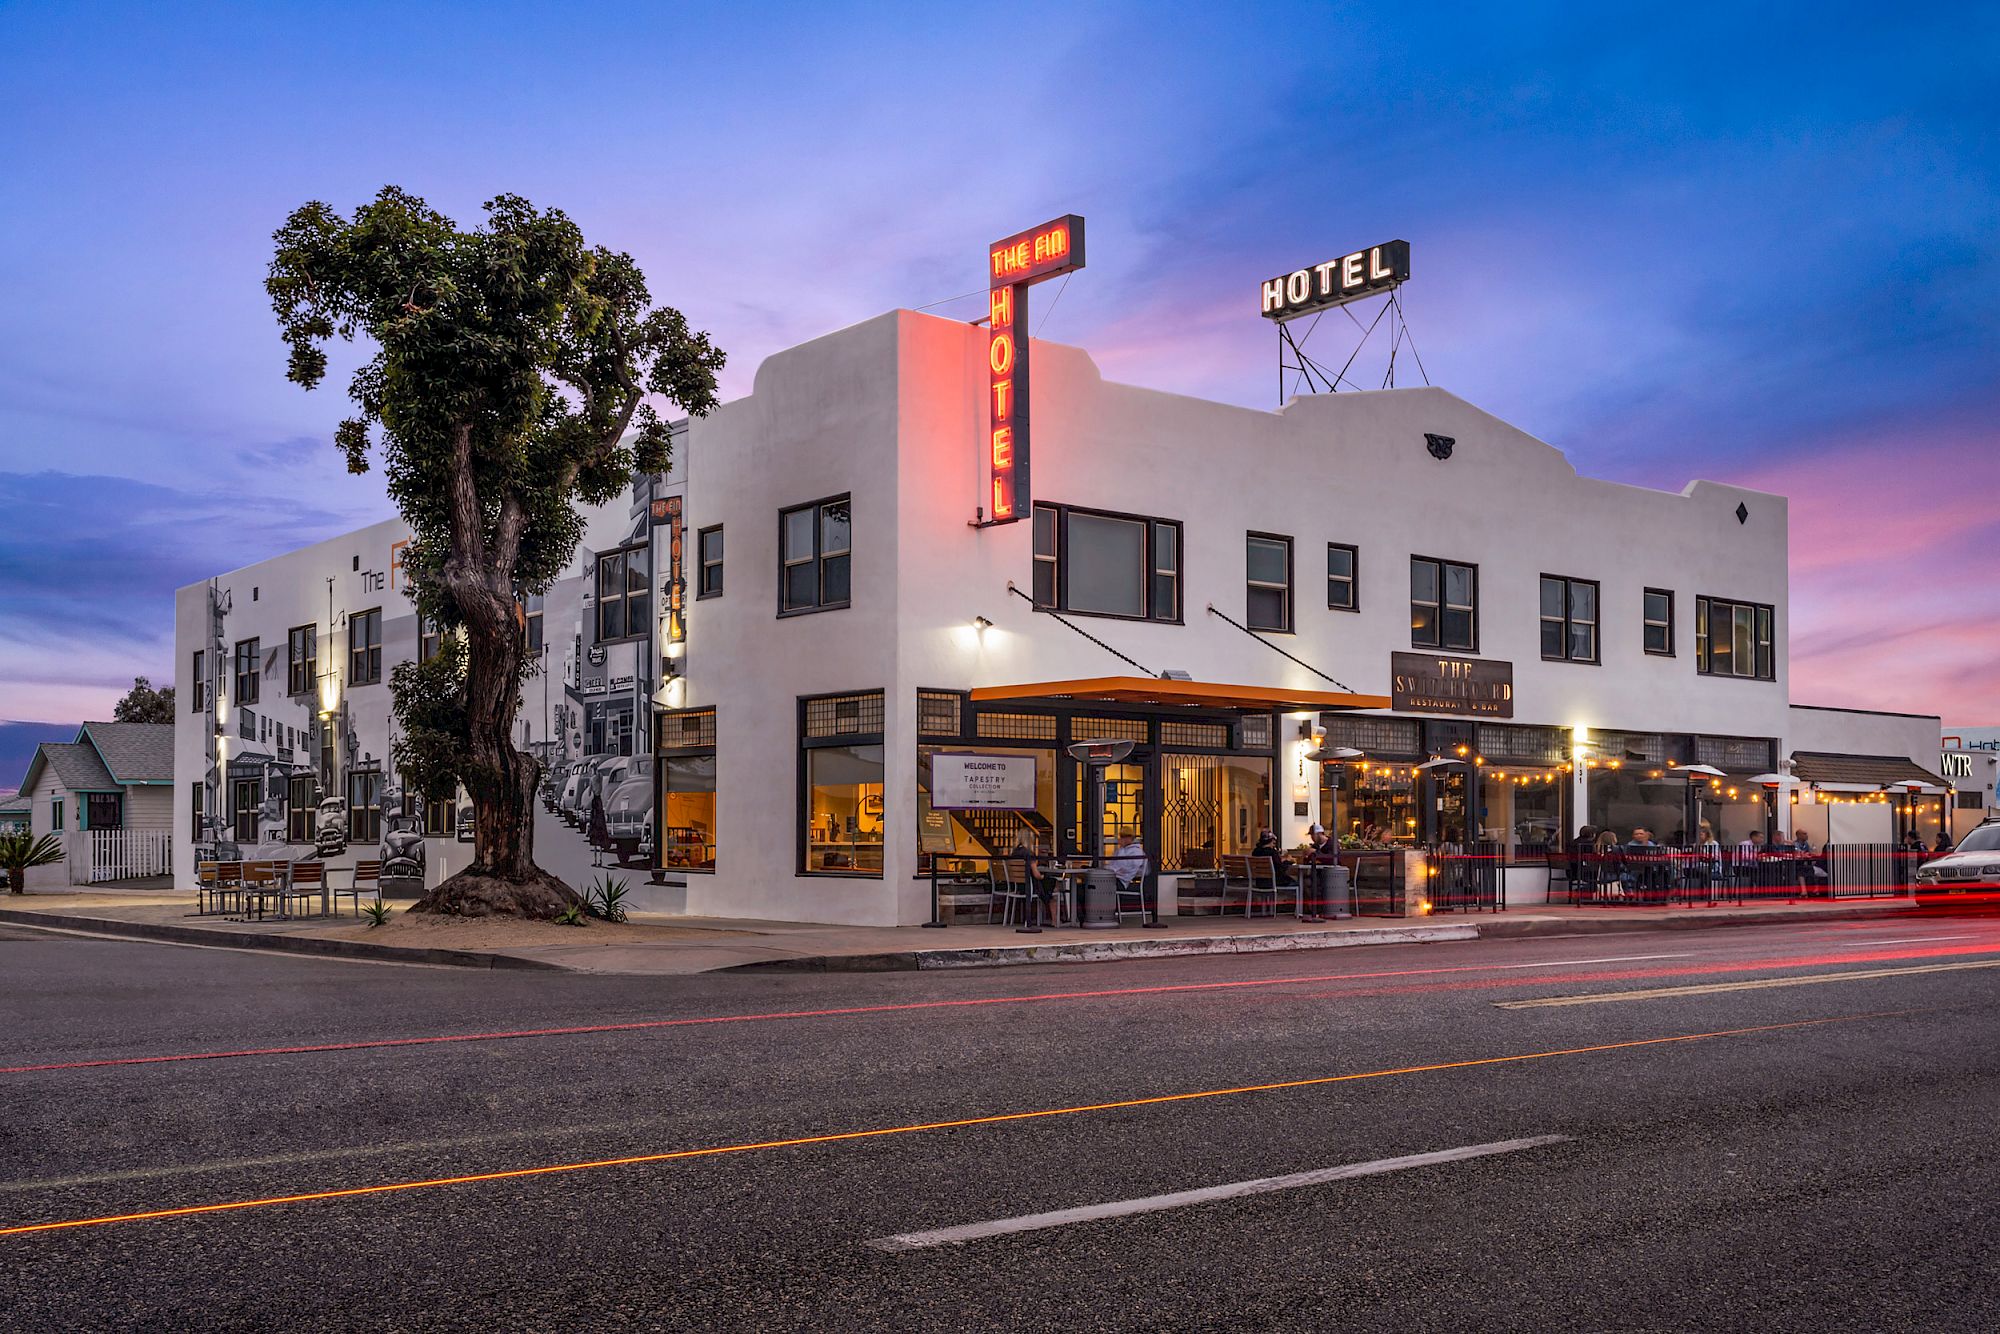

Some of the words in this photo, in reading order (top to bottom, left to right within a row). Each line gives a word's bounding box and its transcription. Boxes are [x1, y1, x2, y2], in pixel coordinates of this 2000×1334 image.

[991, 241, 1031, 279] THE
[1262, 247, 1392, 312] HOTEL
[990, 285, 1012, 517] HOTEL
[361, 568, 385, 594] The
[671, 516, 682, 638] HOTEL
[1438, 660, 1472, 679] THE
[1481, 704, 1499, 712] BAR
[964, 762, 997, 771] WELCOME
[998, 763, 1006, 771] TO
[1941, 753, 1973, 777] WTR
[964, 775, 1006, 783] TAPESTRY
